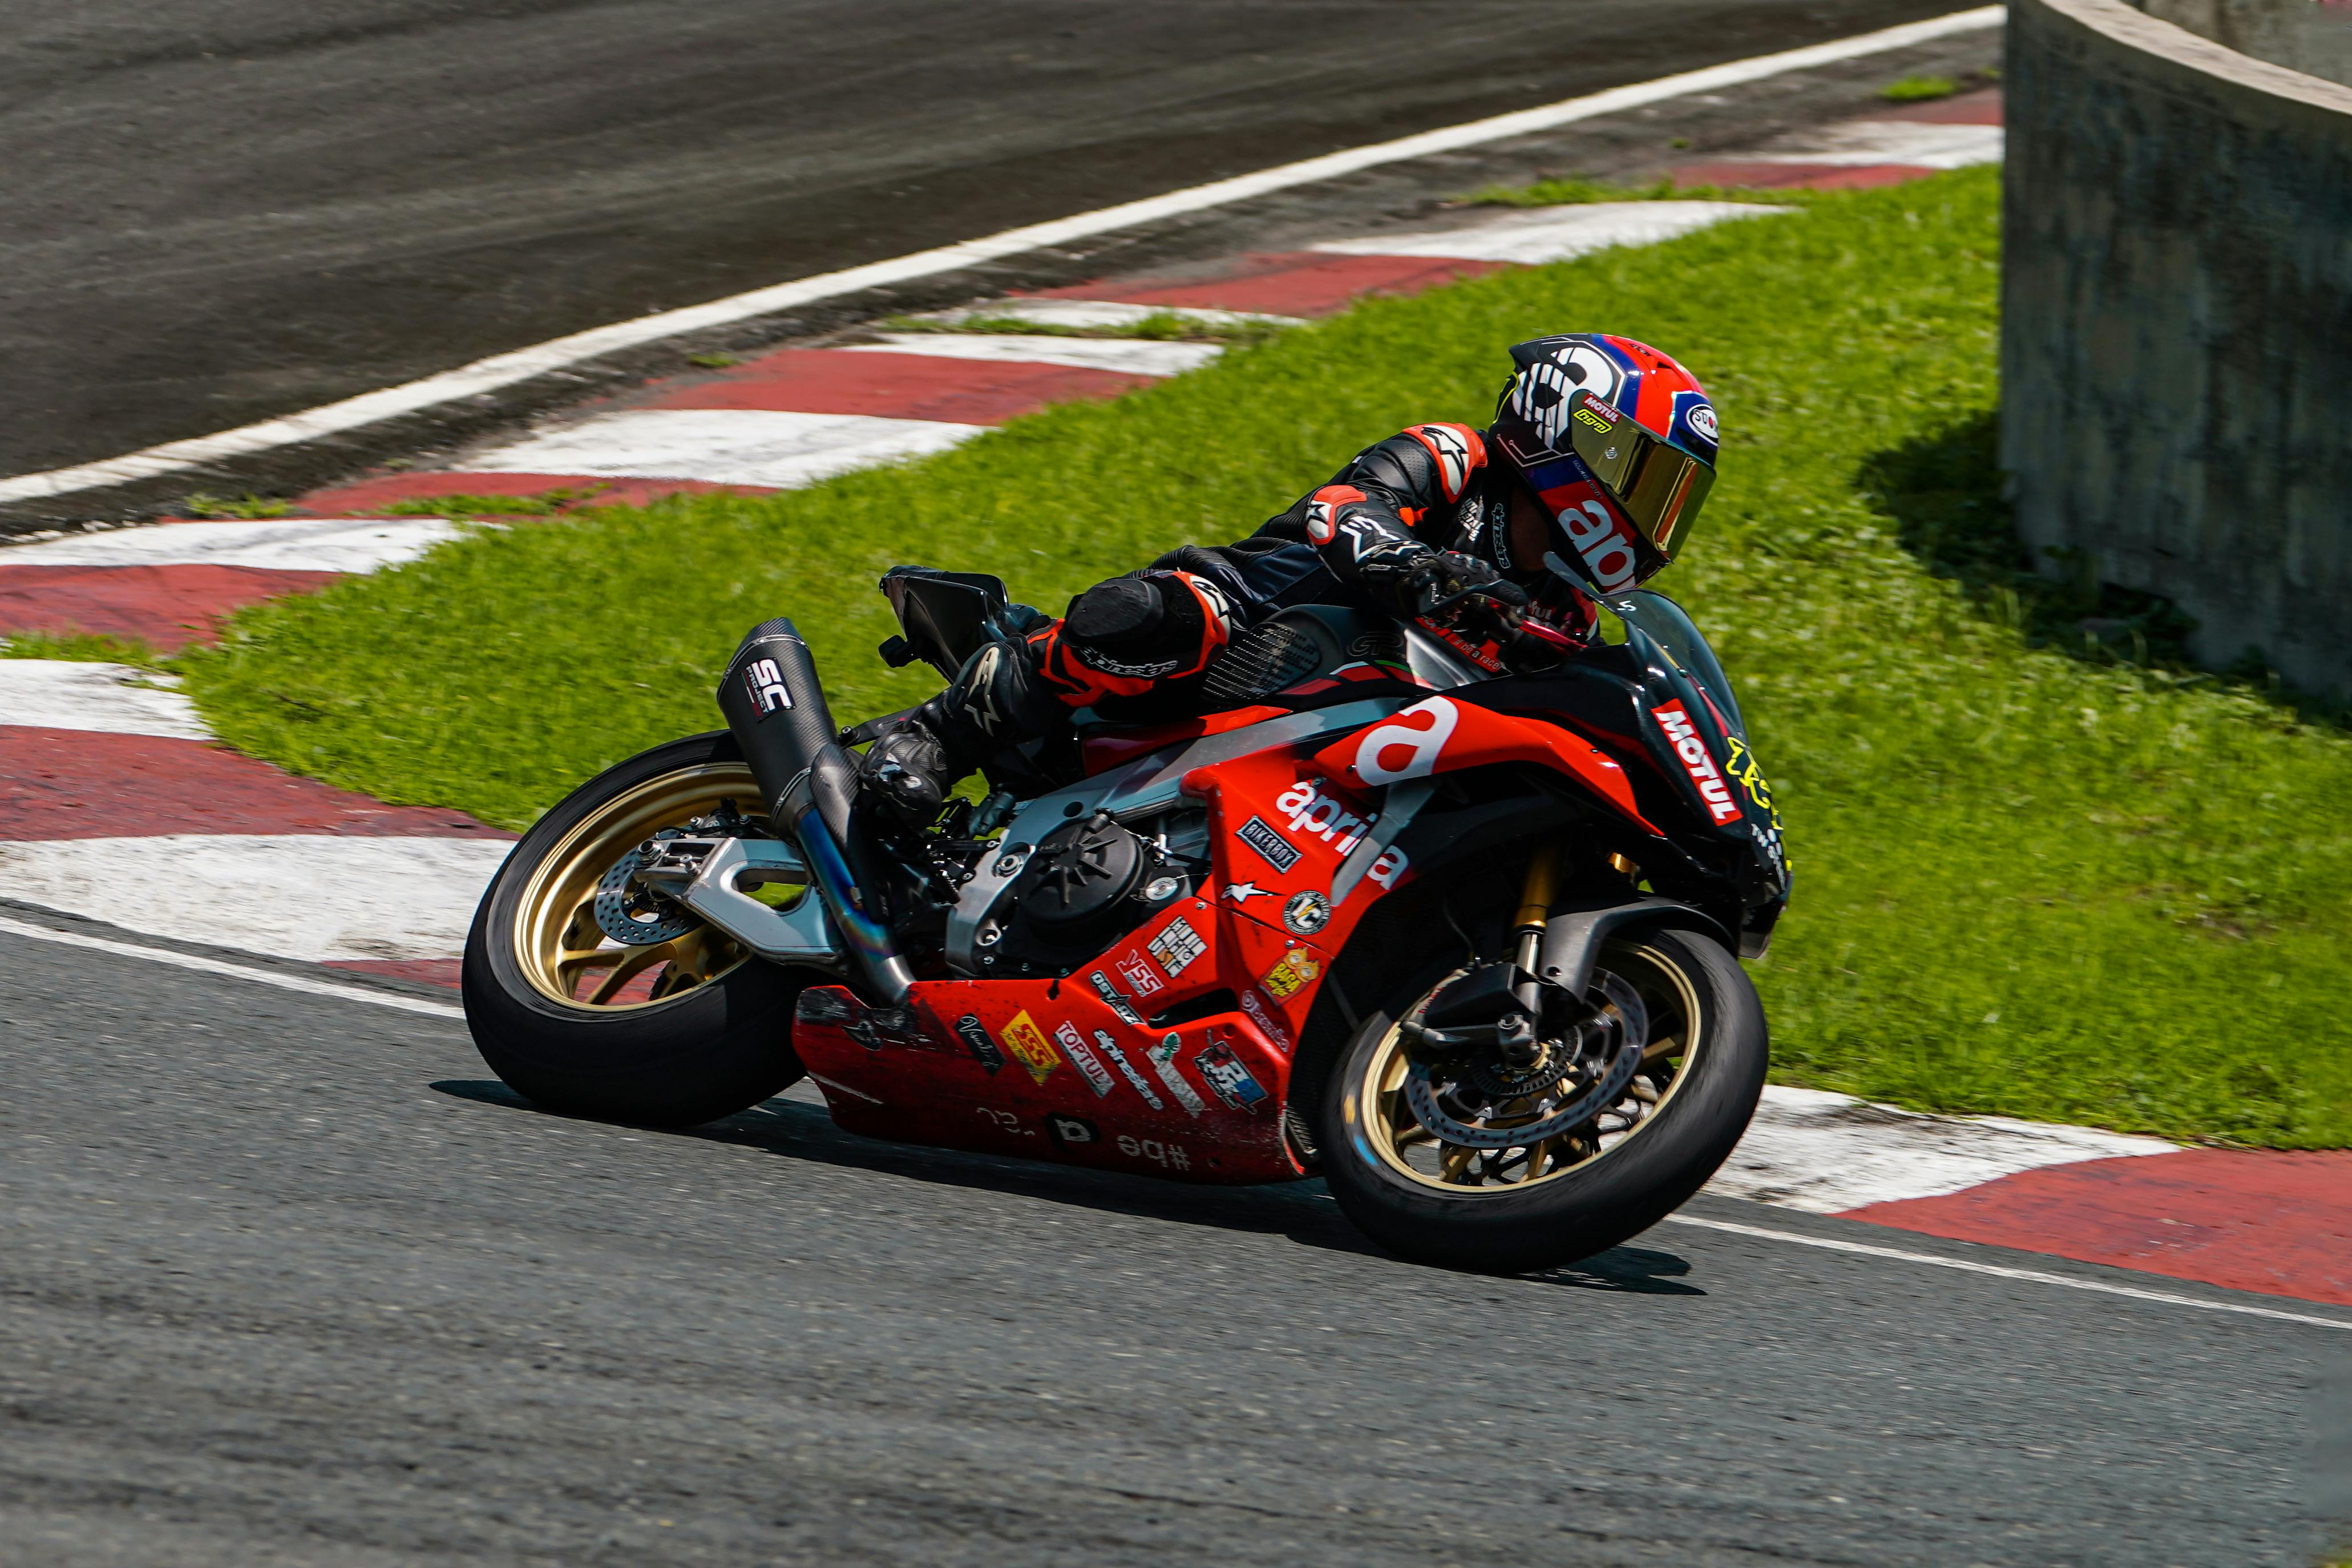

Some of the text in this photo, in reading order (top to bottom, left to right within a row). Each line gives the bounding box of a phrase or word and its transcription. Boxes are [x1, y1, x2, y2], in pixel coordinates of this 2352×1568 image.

[1584, 397, 1619, 422] MOTUL
[746, 665, 769, 713] PROJECT
[751, 659, 792, 711] SC
[1657, 710, 1736, 819] MOTUL
[1244, 824, 1295, 866] BIKERBOX
[1276, 782, 1409, 890] apria
[1116, 949, 1165, 996] YSS
[1058, 1022, 1108, 1084] TOPTUL
